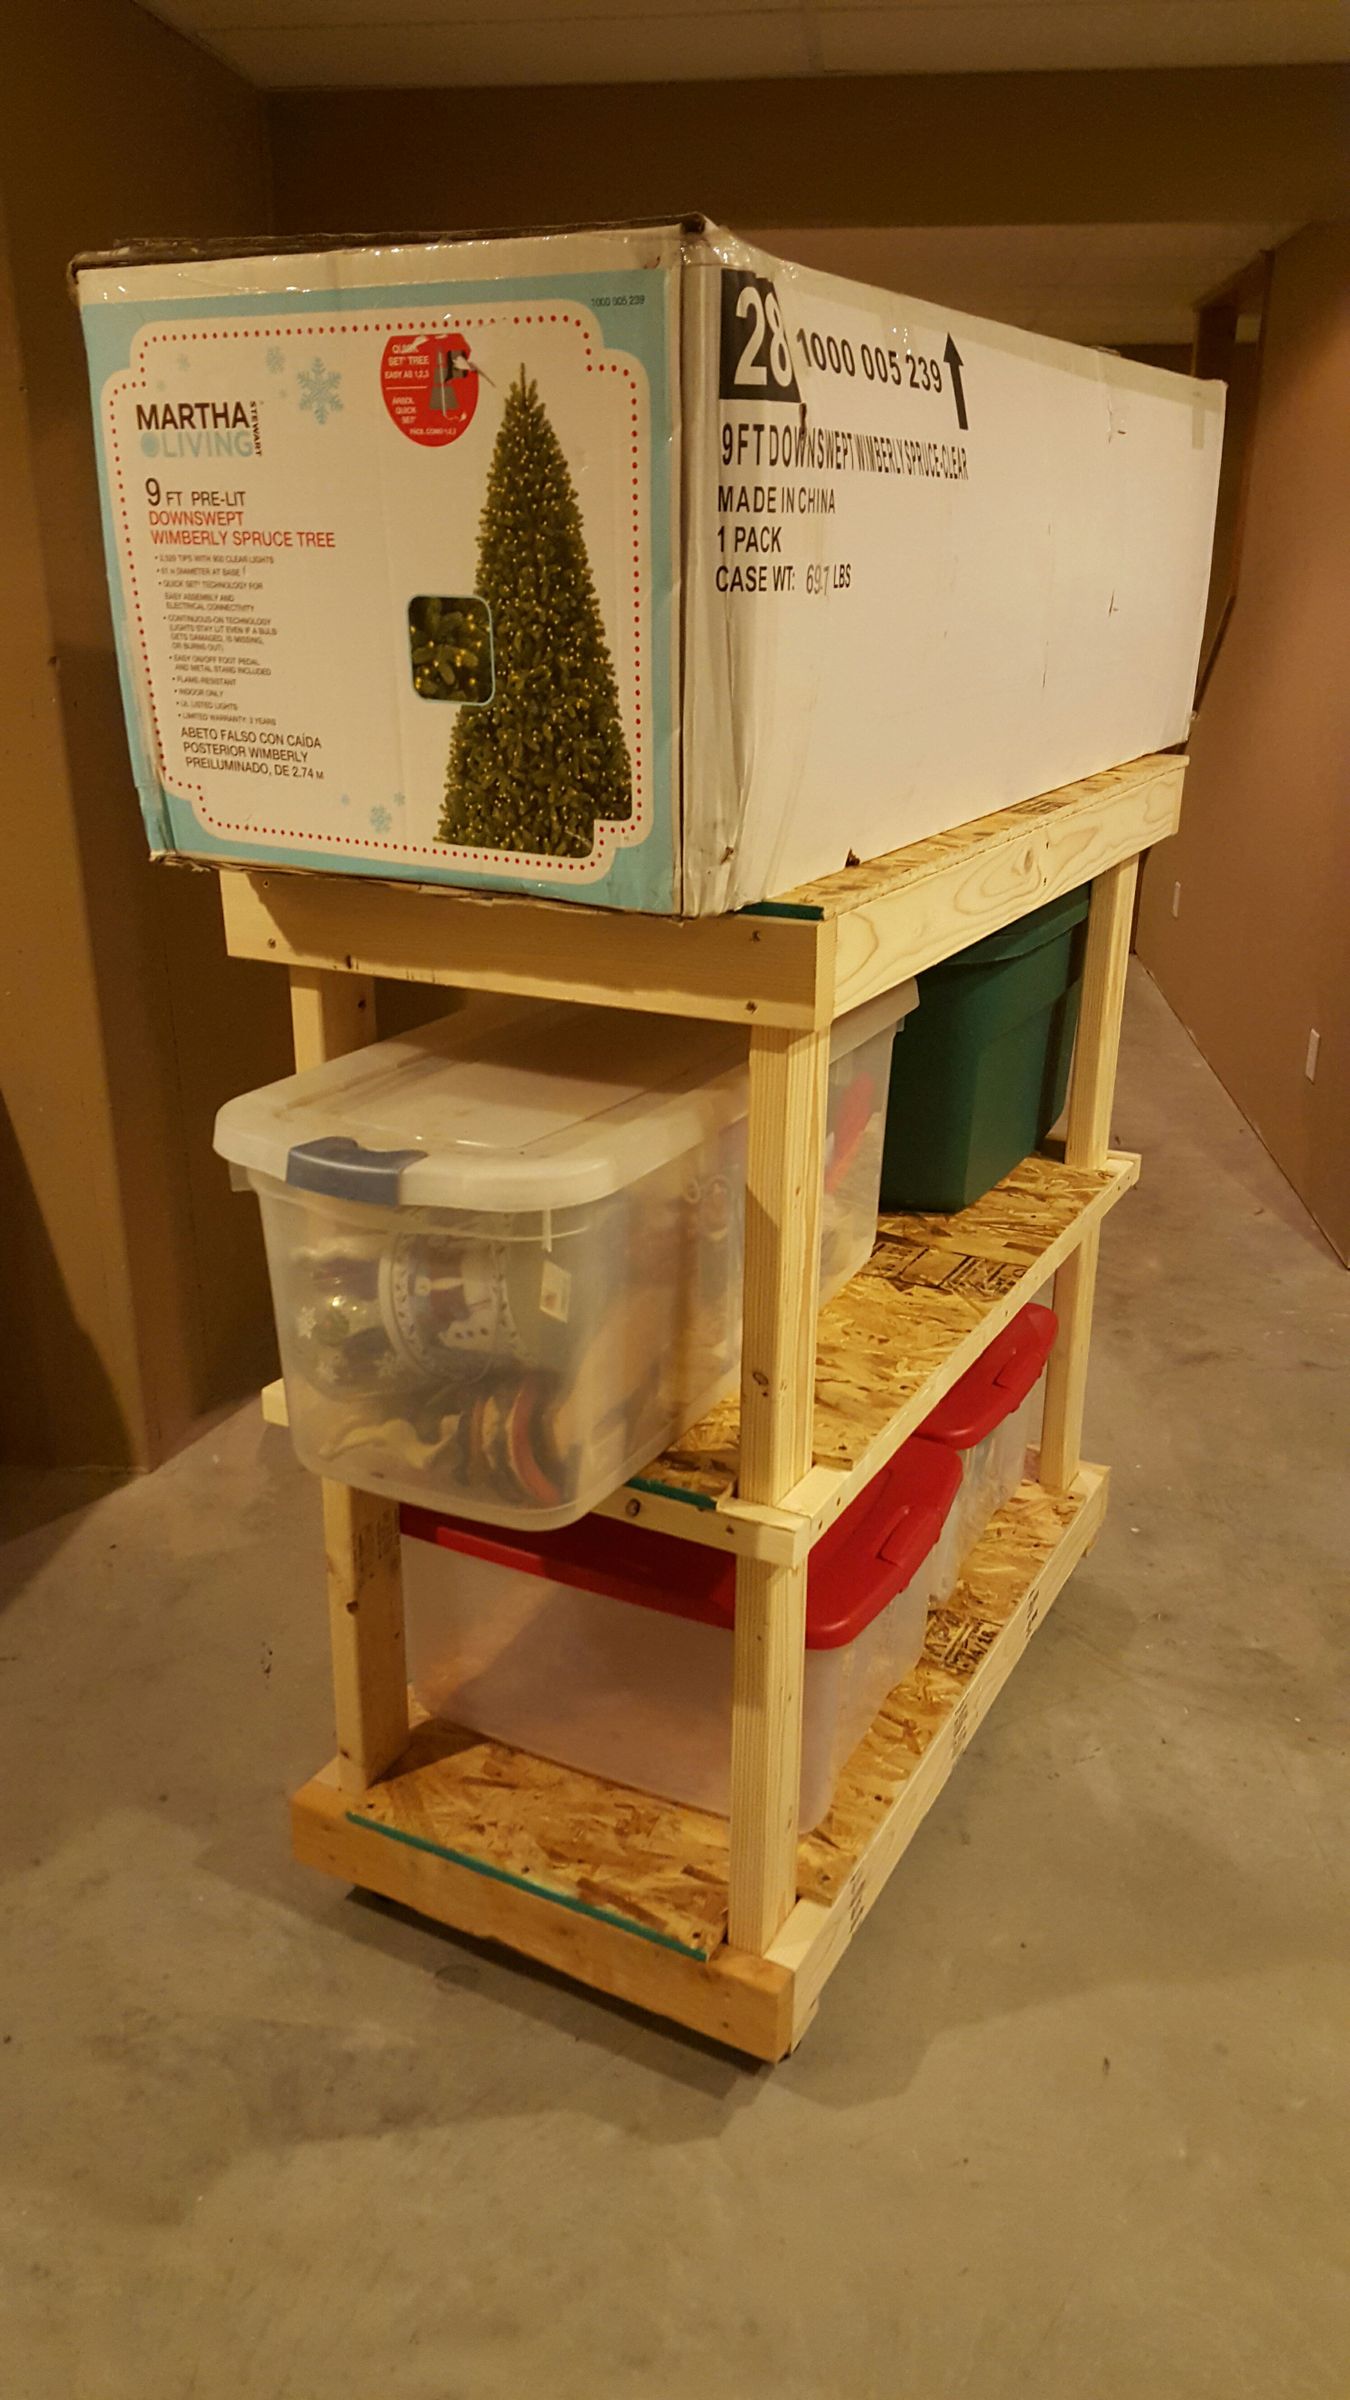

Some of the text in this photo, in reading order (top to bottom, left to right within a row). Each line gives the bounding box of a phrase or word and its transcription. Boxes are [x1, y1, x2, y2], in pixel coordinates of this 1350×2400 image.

[733, 286, 793, 388] 28
[408, 355, 430, 365] TREE
[797, 327, 943, 394] 1000 005 239
[135, 401, 251, 431] MARTHA
[249, 400, 262, 457] STEWART
[161, 431, 254, 458] LIVING
[720, 423, 733, 466] 9
[737, 423, 765, 467] FT
[768, 424, 855, 470] DOWNSWEPT
[852, 432, 906, 475] WIMBERLY
[145, 477, 246, 507] 9 FT PRE-LIT
[717, 485, 836, 514] MADE IN CHINA
[149, 510, 244, 526] DOWNSWEPT
[150, 529, 336, 548] WIMBERLY SPRUCE TREE
[717, 526, 782, 553] 1 PACK
[716, 566, 768, 592] CASE
[772, 565, 796, 592] WT:
[833, 563, 851, 589] LBS
[180, 726, 323, 749] ABETO FALSO CON CAÍDA
[183, 741, 309, 763] POSTERIOR WIMBERLY
[185, 756, 272, 777] PREILUMINADO,
[274, 764, 290, 777] DE
[292, 766, 315, 779] 2.74
